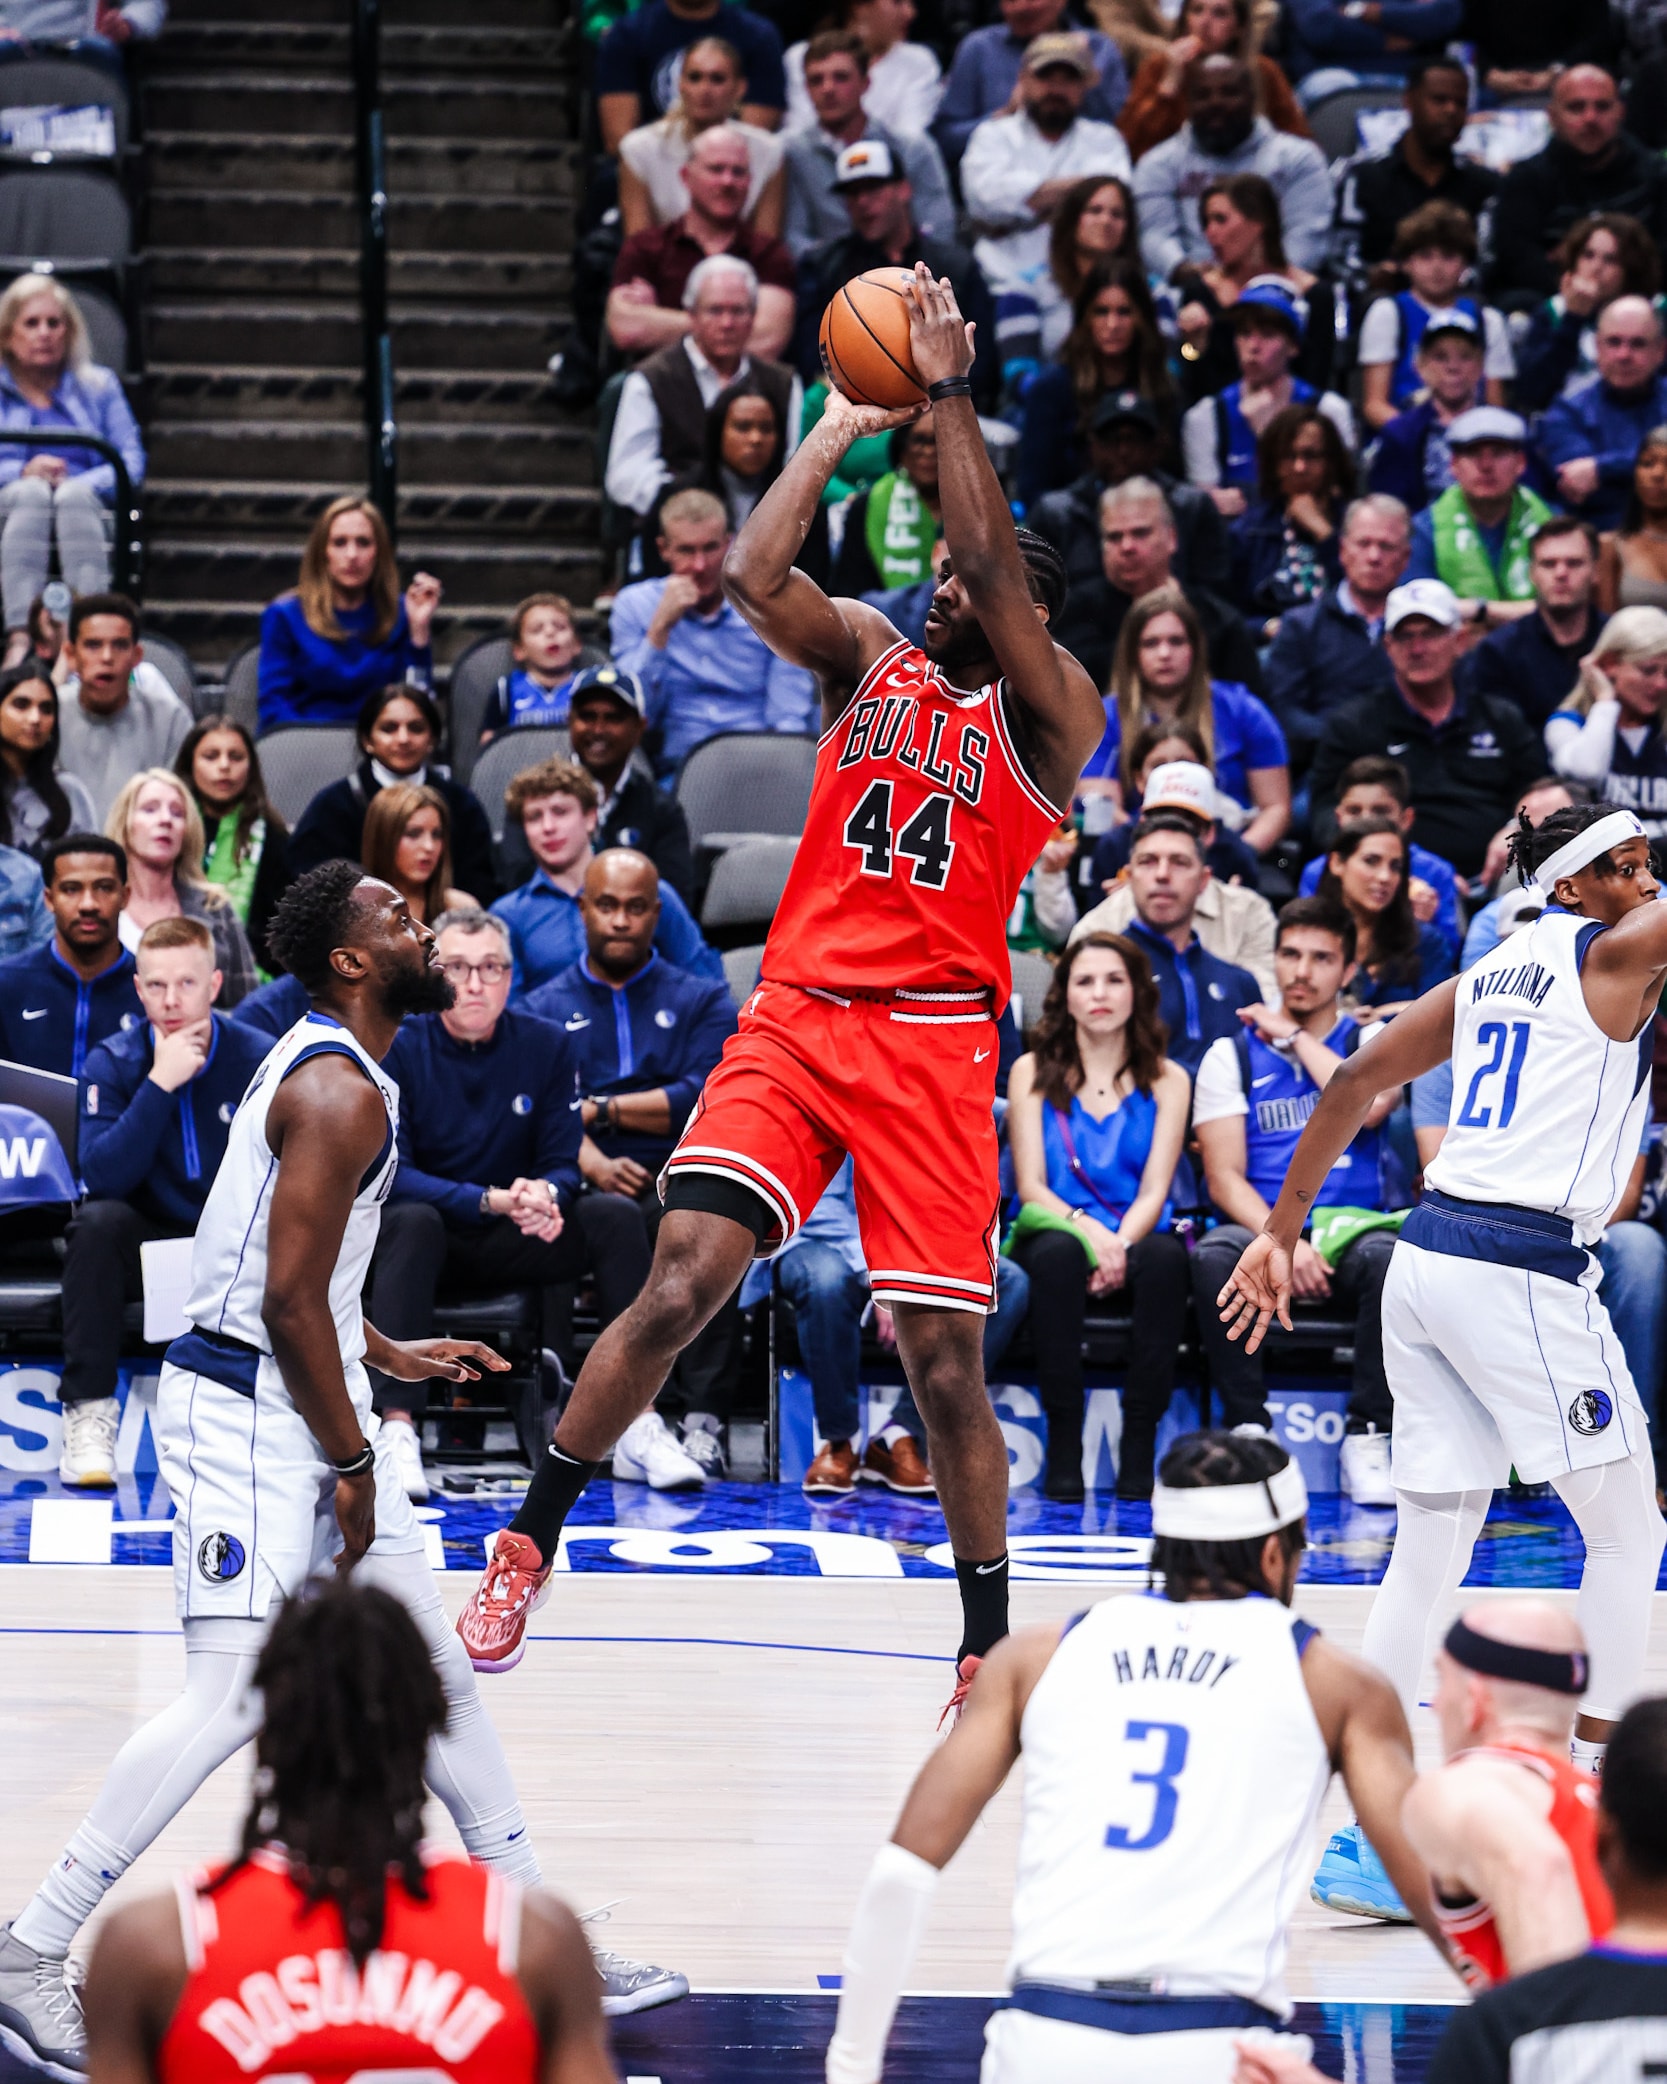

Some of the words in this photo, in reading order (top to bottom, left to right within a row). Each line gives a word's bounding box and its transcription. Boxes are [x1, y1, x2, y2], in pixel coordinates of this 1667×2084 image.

[836, 695, 990, 807] BULLS
[842, 778, 956, 892] 44
[1456, 1021, 1531, 1130] 21
[1112, 1645, 1241, 1688] HARDY
[1103, 1719, 1190, 1852] 3
